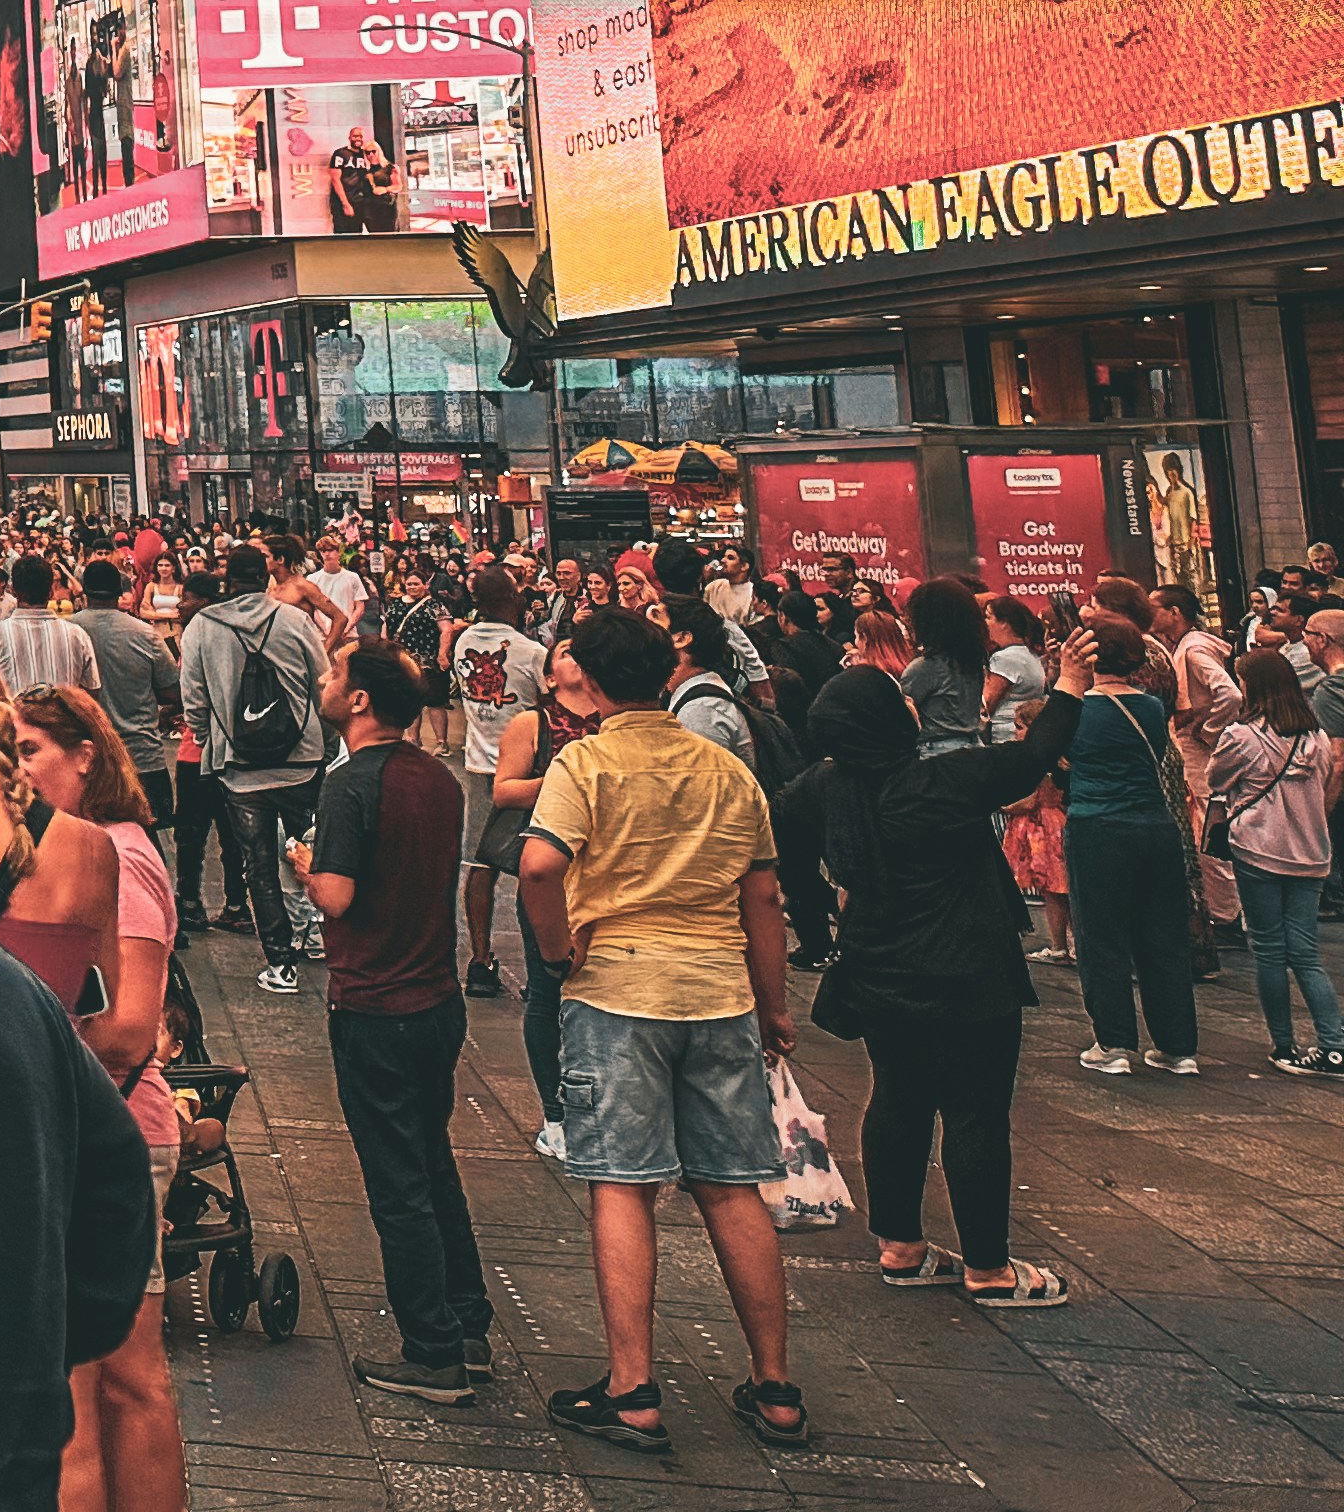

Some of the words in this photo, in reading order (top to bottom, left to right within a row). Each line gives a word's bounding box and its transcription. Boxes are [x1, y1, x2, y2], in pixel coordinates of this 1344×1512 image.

[358, 8, 531, 55] CUSTO
[557, 24, 599, 57] shop
[594, 68, 605, 97] &
[65, 226, 81, 252] WE
[92, 216, 111, 245] OUR
[111, 198, 169, 239] CUSTOMERS
[675, 182, 914, 288] AMERICAN
[936, 143, 1129, 242] EAGLE
[57, 412, 112, 441] SEPHORA
[335, 455, 357, 465] THE
[359, 455, 384, 465] BEST
[400, 454, 455, 465] COVERAGE
[1122, 458, 1142, 536] Newsstand
[1024, 520, 1056, 537] Get
[792, 530, 819, 552] Get
[819, 530, 887, 559] Broadway
[998, 540, 1084, 558] Broadway
[1005, 560, 1063, 576] tickets
[1066, 559, 1083, 576] in
[1008, 579, 1085, 596] seconds.
